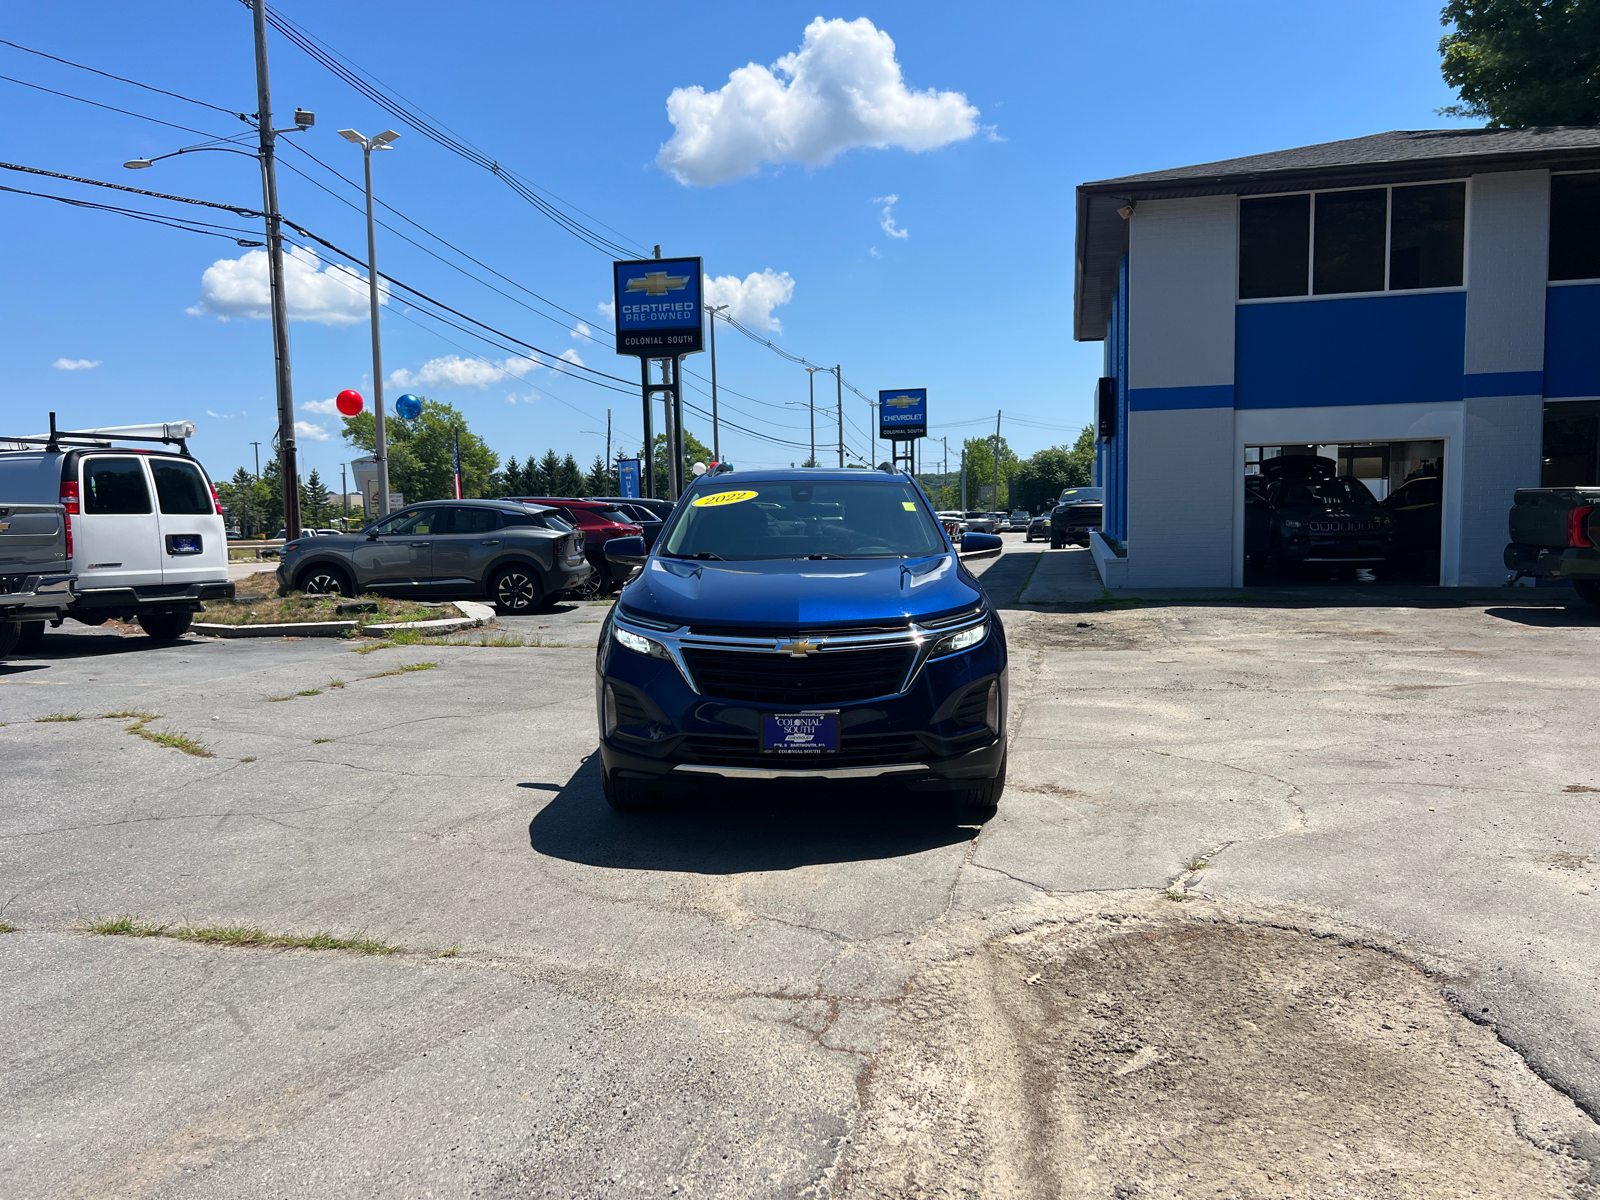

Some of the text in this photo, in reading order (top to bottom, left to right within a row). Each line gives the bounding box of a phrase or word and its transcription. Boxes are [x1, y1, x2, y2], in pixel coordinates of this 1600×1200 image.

[622, 302, 694, 313] CERTIFIED
[626, 311, 691, 321] PRE-OWNED
[625, 335, 693, 346] COLONIAL SOUTH
[883, 413, 923, 421] CHEVROLET
[704, 492, 747, 505] 2022
[776, 718, 822, 726] COLONIAL
[783, 725, 815, 733] SOUTH
